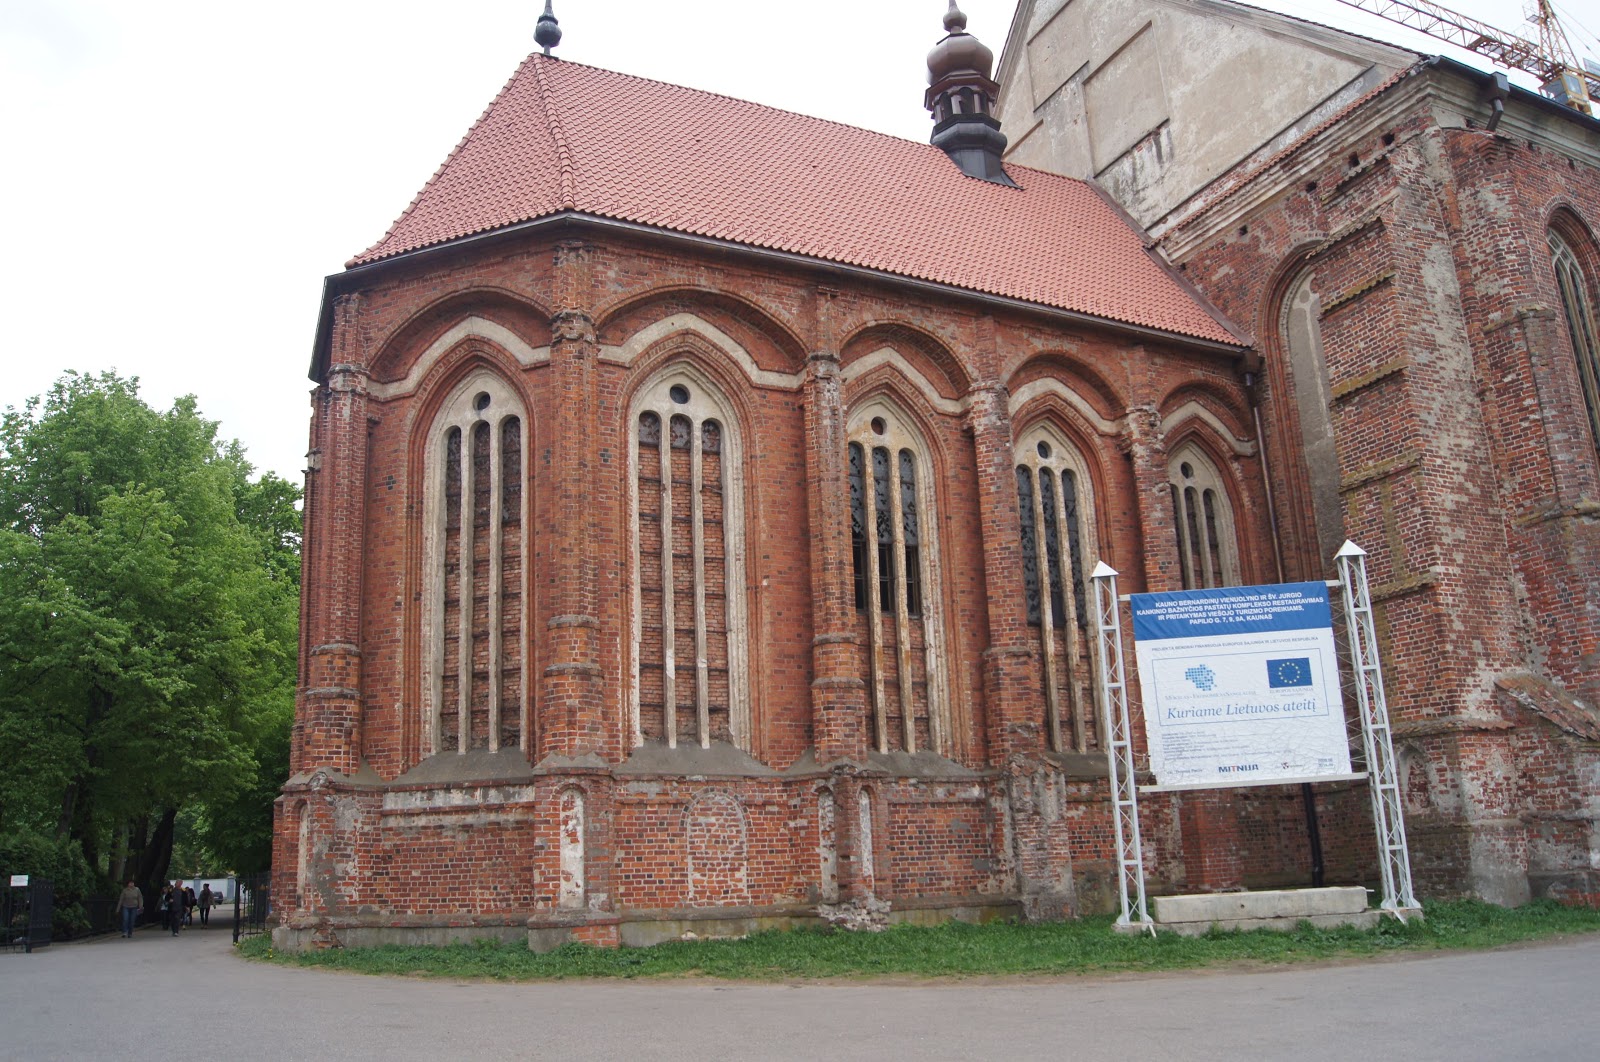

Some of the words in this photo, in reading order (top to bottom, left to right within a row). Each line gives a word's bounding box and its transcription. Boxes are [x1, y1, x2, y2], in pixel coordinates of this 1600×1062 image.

[1168, 605, 1202, 613] BAŽNYČIOS
[1272, 597, 1324, 605] RESTAURAVIMAS
[1179, 598, 1219, 606] BERNARDINŲ
[1167, 707, 1222, 719] Kuriame
[1226, 704, 1280, 715] Lietuvos
[1283, 699, 1316, 712] ateitį
[1218, 764, 1259, 772] MITNIJA
